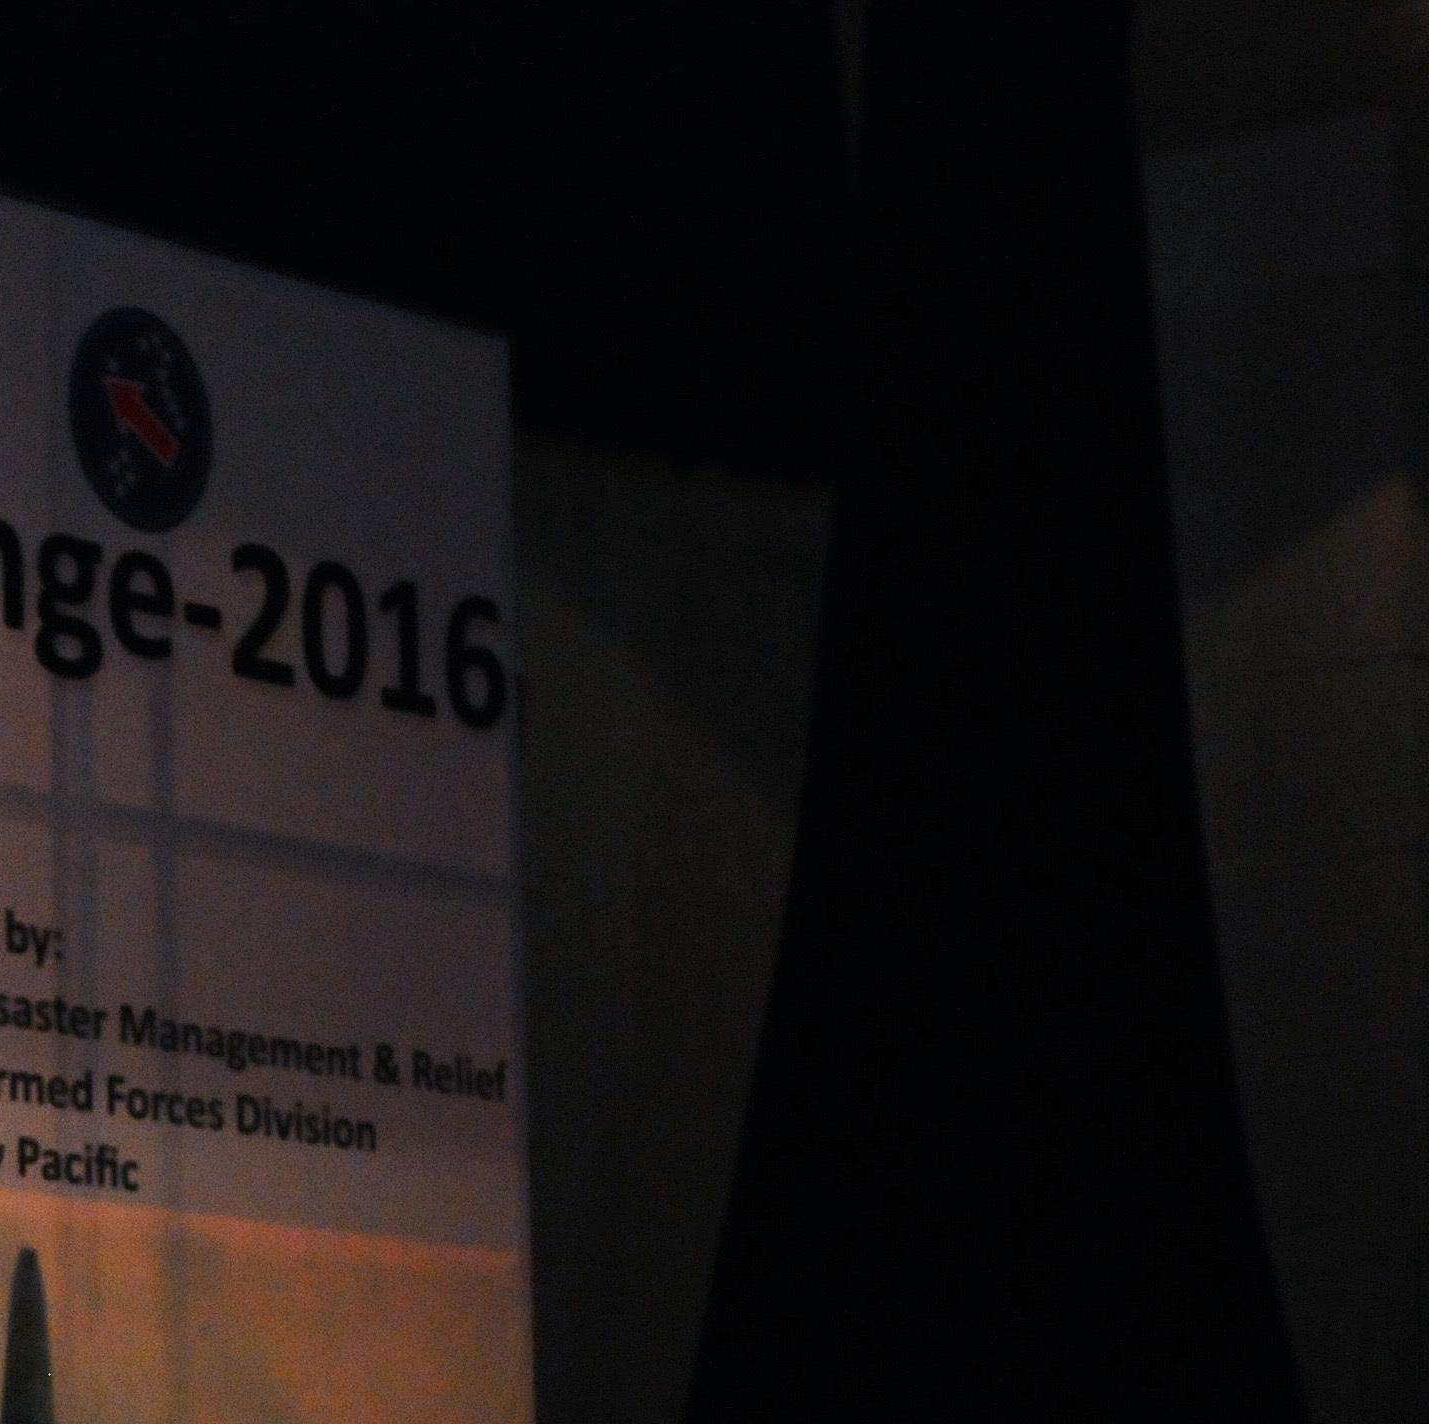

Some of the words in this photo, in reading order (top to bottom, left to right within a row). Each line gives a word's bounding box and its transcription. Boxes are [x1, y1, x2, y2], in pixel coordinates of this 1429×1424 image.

[5, 908, 64, 967] by:
[119, 1004, 363, 1080] Management
[373, 1043, 400, 1086] &
[412, 1049, 508, 1101] Relief
[106, 1074, 224, 1131] Forces
[236, 1094, 377, 1151] Division
[17, 1136, 139, 1193] Pacific
